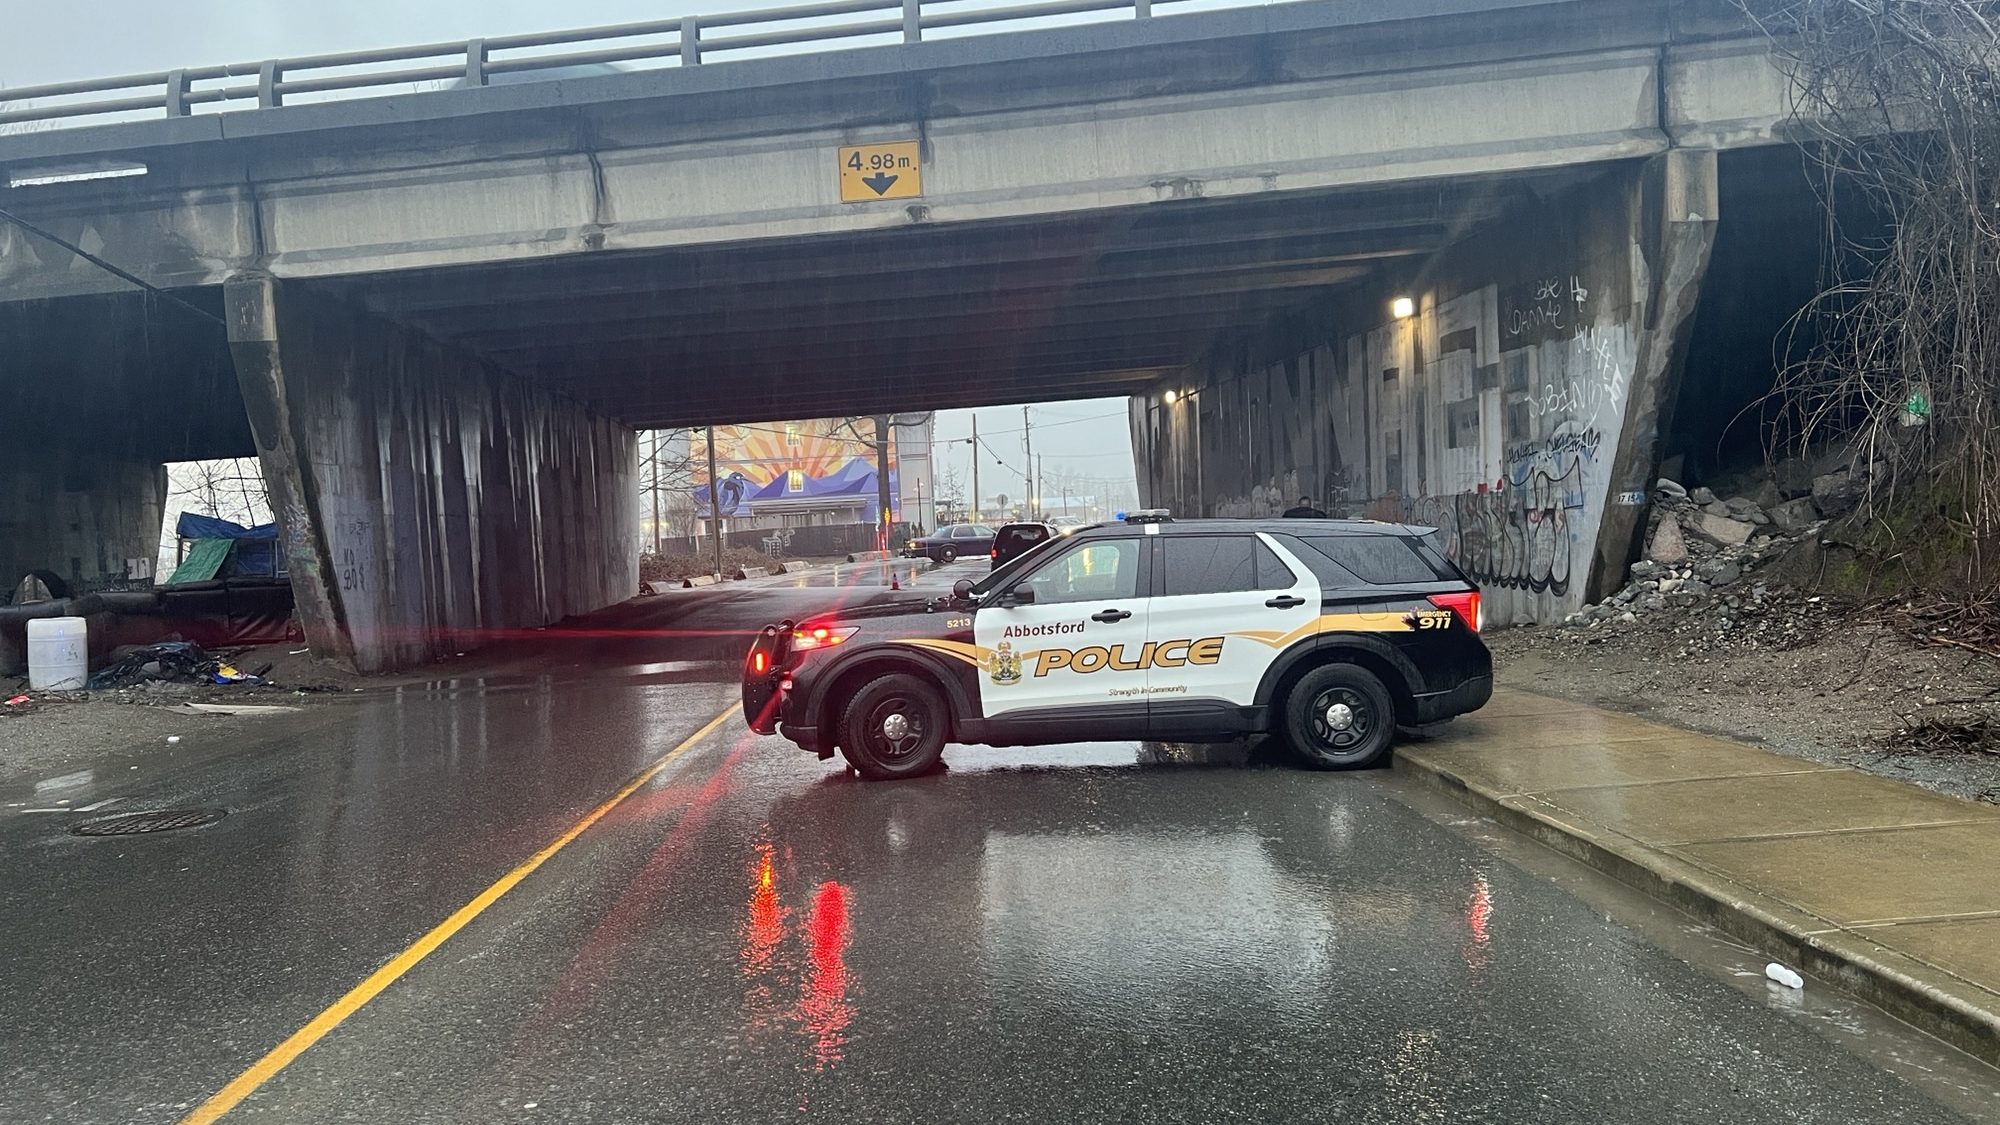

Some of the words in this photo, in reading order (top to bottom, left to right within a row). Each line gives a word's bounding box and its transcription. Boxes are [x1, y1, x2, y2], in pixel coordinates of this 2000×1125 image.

[946, 618, 971, 629] 5213
[1003, 620, 1085, 638] Abbotsford
[1419, 617, 1451, 630] 911
[1034, 636, 1225, 677] POLICE
[1108, 688, 1139, 697] Strength
[1149, 685, 1188, 694] Community
